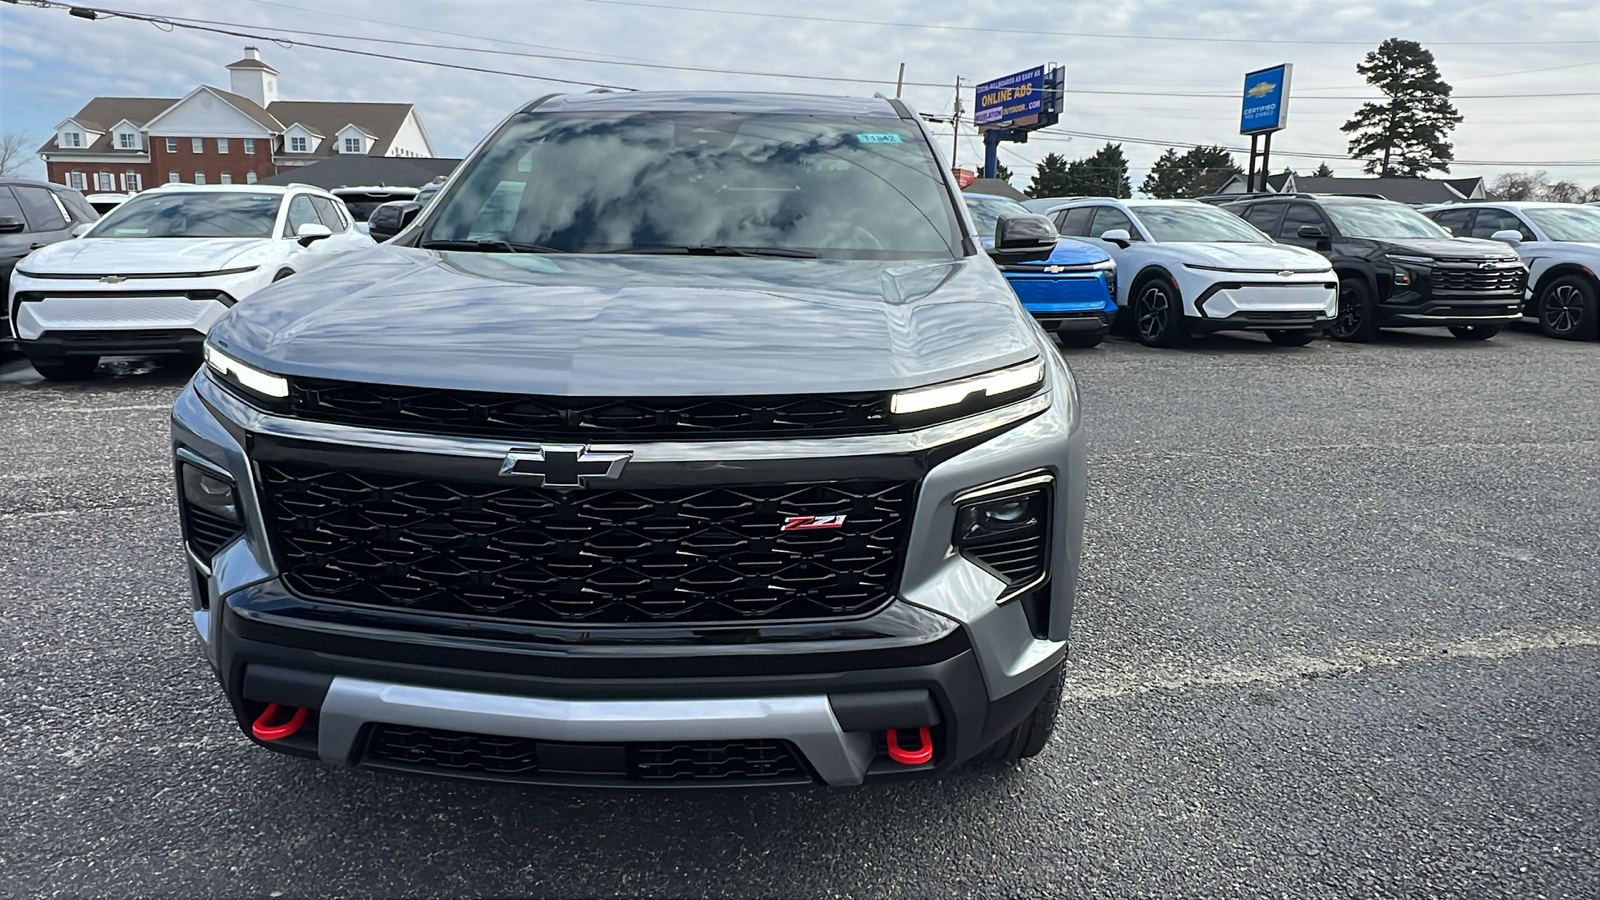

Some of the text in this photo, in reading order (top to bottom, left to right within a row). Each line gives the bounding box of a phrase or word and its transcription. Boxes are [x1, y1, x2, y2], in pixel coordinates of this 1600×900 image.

[1022, 72, 1033, 81] EASY
[1034, 69, 1040, 77] AS
[981, 83, 1032, 107] ONLINE ADS
[1244, 103, 1276, 115] CERTIFIED
